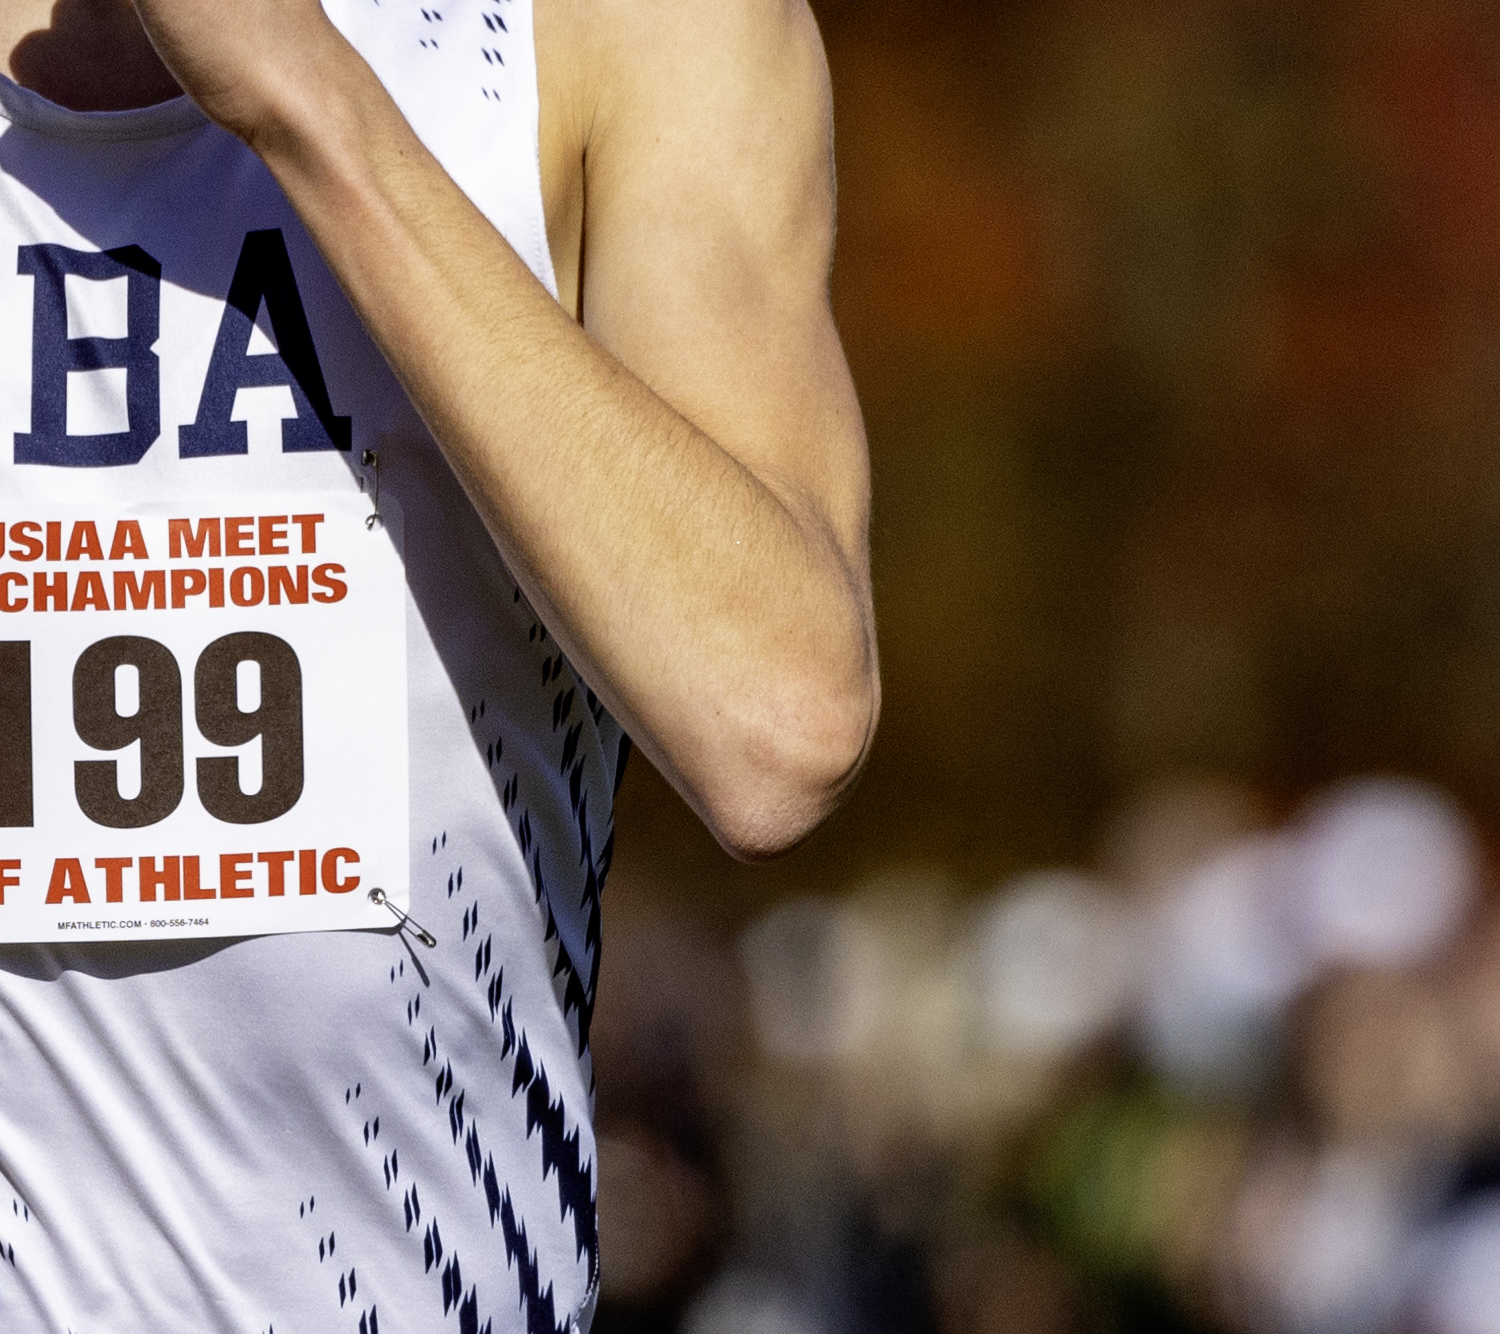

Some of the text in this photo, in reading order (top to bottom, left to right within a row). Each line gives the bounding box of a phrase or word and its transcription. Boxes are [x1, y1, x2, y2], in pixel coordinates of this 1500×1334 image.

[168, 514, 325, 558] MEET
[45, 847, 361, 904] ATHLETIC
[57, 920, 142, 930] MFATHLETIC.COM
